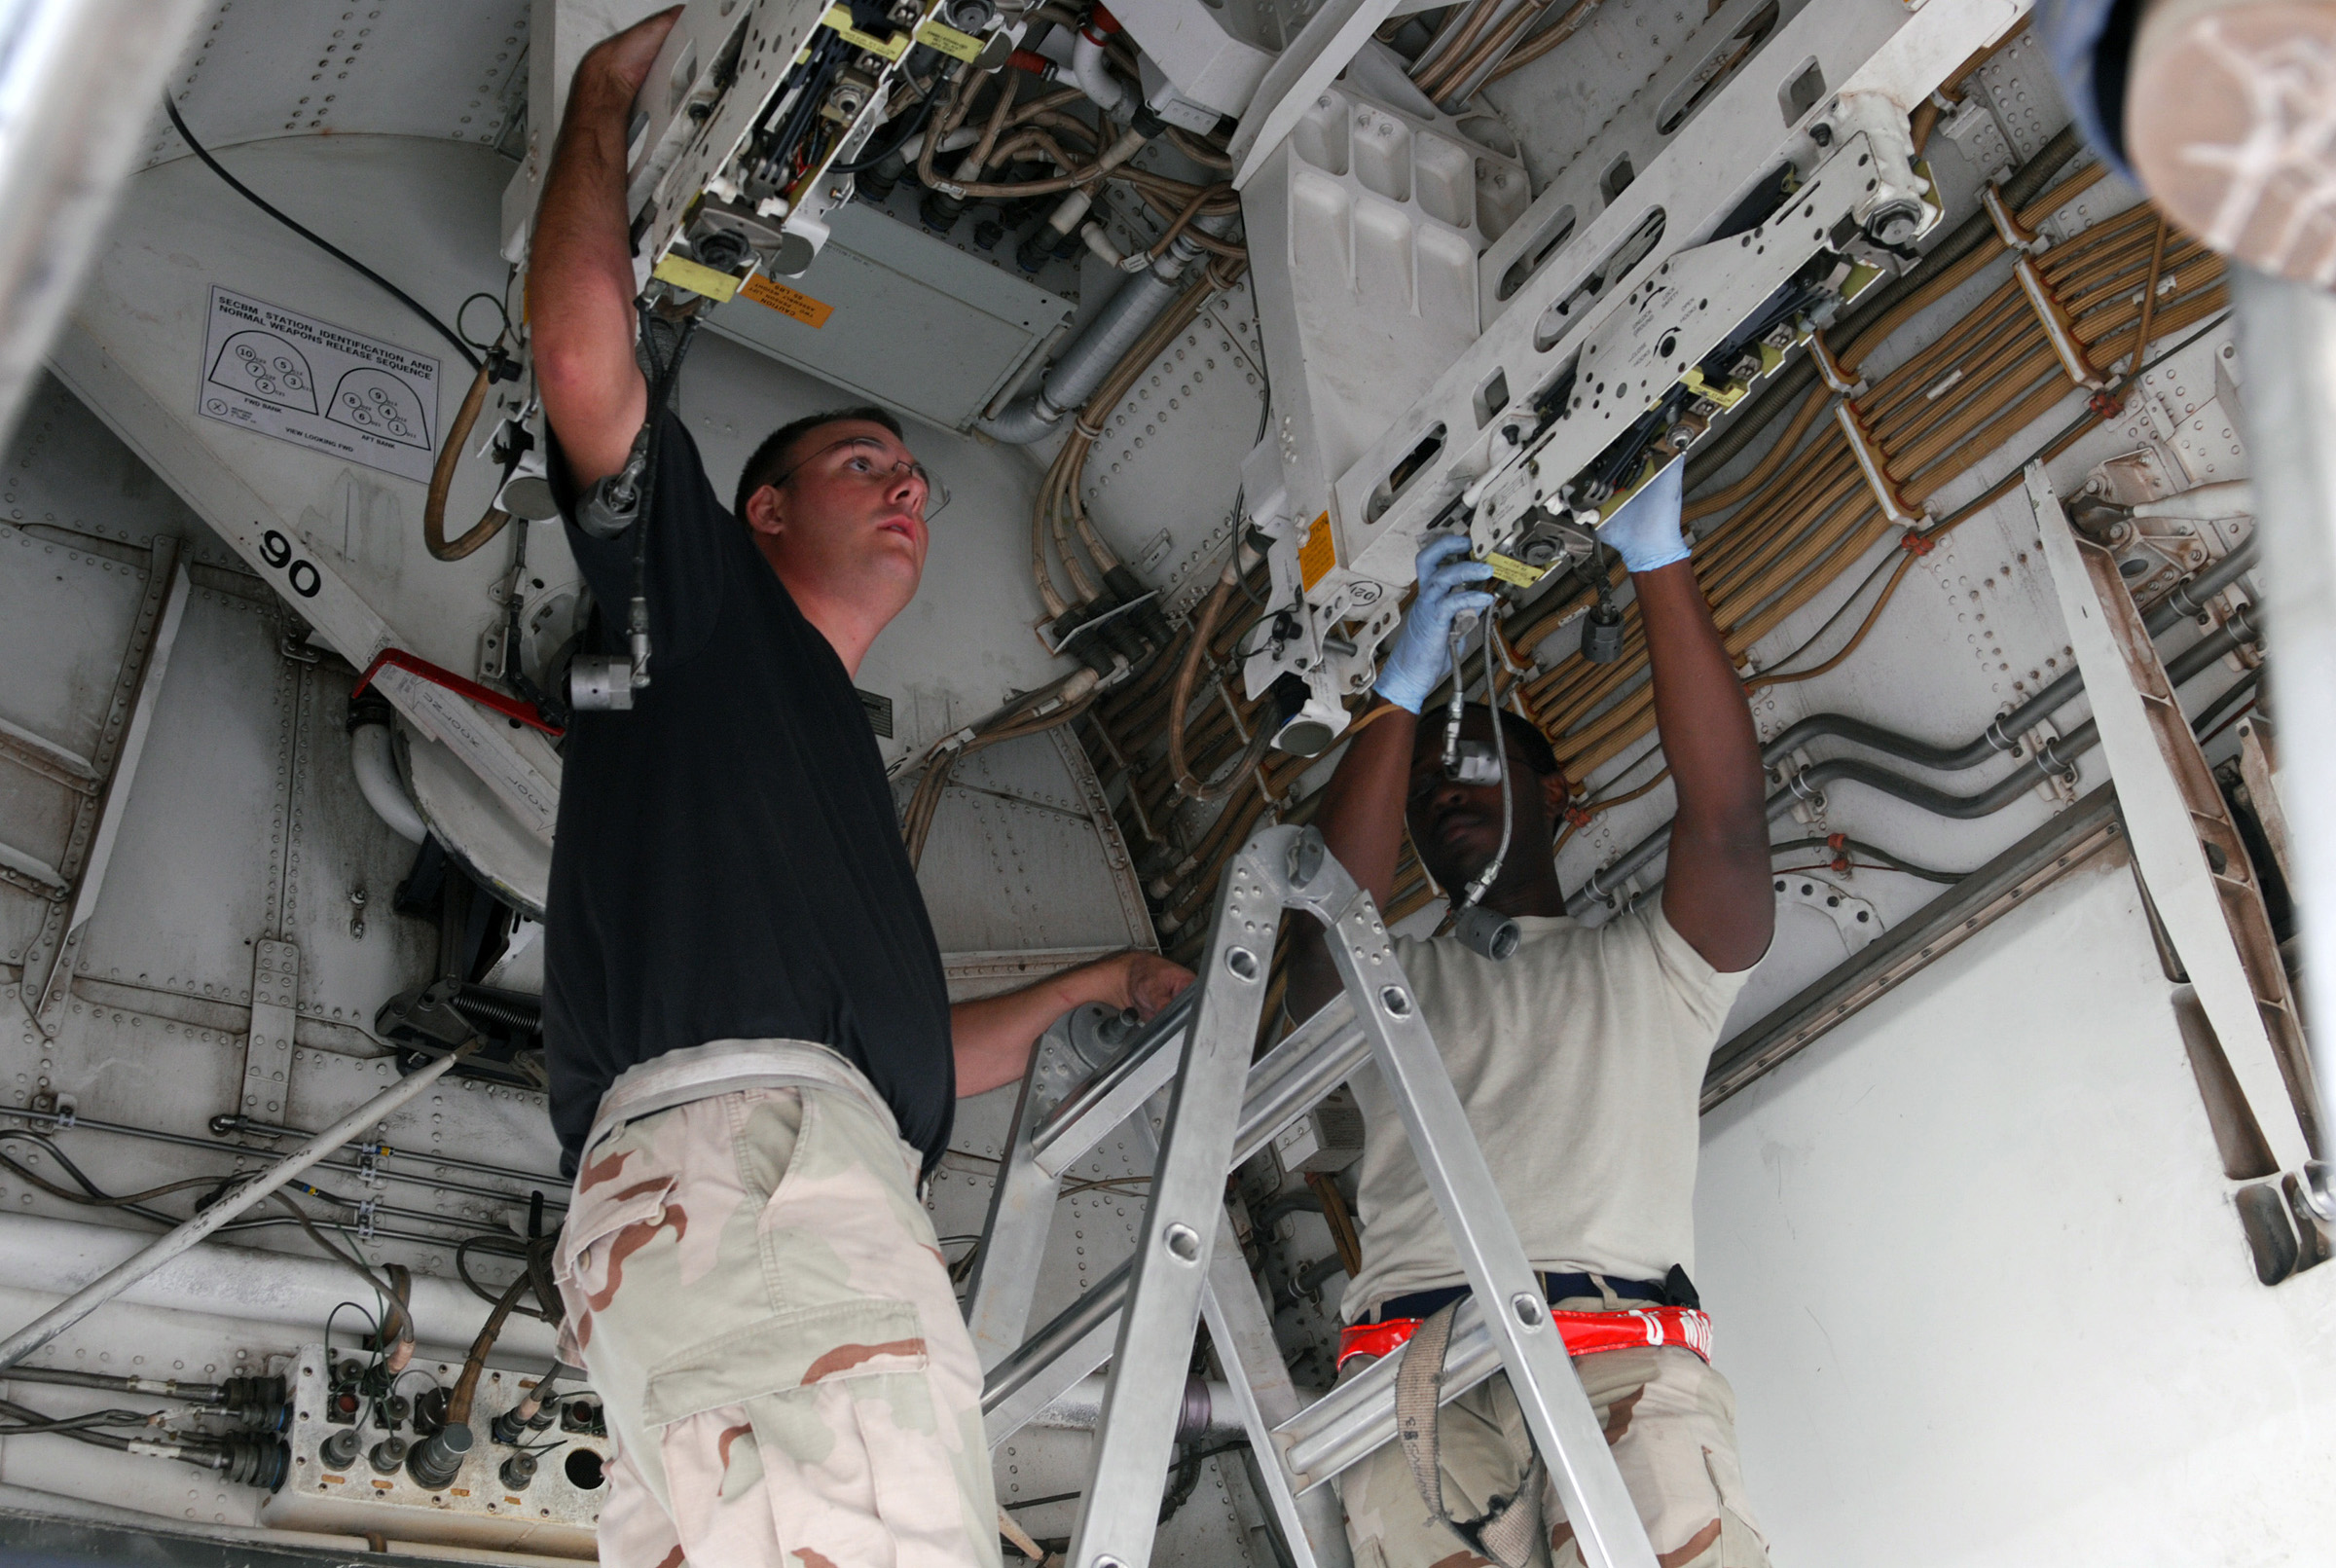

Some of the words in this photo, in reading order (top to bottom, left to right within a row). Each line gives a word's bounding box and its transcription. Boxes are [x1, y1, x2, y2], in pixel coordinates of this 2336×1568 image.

[754, 283, 780, 296] WEIGHT
[760, 298, 796, 316] CAUTION
[765, 294, 791, 308] PERSON
[783, 295, 815, 311] ASSEMBLY
[1681, 298, 1695, 311] OPEN
[799, 309, 814, 317] TWO
[219, 296, 258, 314] SECBM
[266, 311, 313, 333] STATION
[319, 329, 404, 363] IDENTIFICATION
[411, 360, 433, 373] AND
[219, 305, 267, 327] NORMAL
[270, 321, 323, 345] WEAPONS
[326, 340, 373, 361] RELEASE
[376, 356, 432, 381] SEQUENCE
[240, 348, 253, 358] 10
[280, 361, 286, 370] 5
[349, 396, 356, 405] 8
[375, 391, 382, 400] 9
[244, 397, 261, 407] FWD
[263, 403, 282, 414] BANK
[285, 426, 303, 437] VIEW
[304, 432, 337, 448] LOOKING
[338, 443, 354, 453] FWD
[361, 434, 374, 444] AFT
[376, 438, 395, 450] BANK
[259, 529, 321, 598] 90
[422, 692, 480, 748] UNLOCK
[507, 776, 550, 816] LOCK
